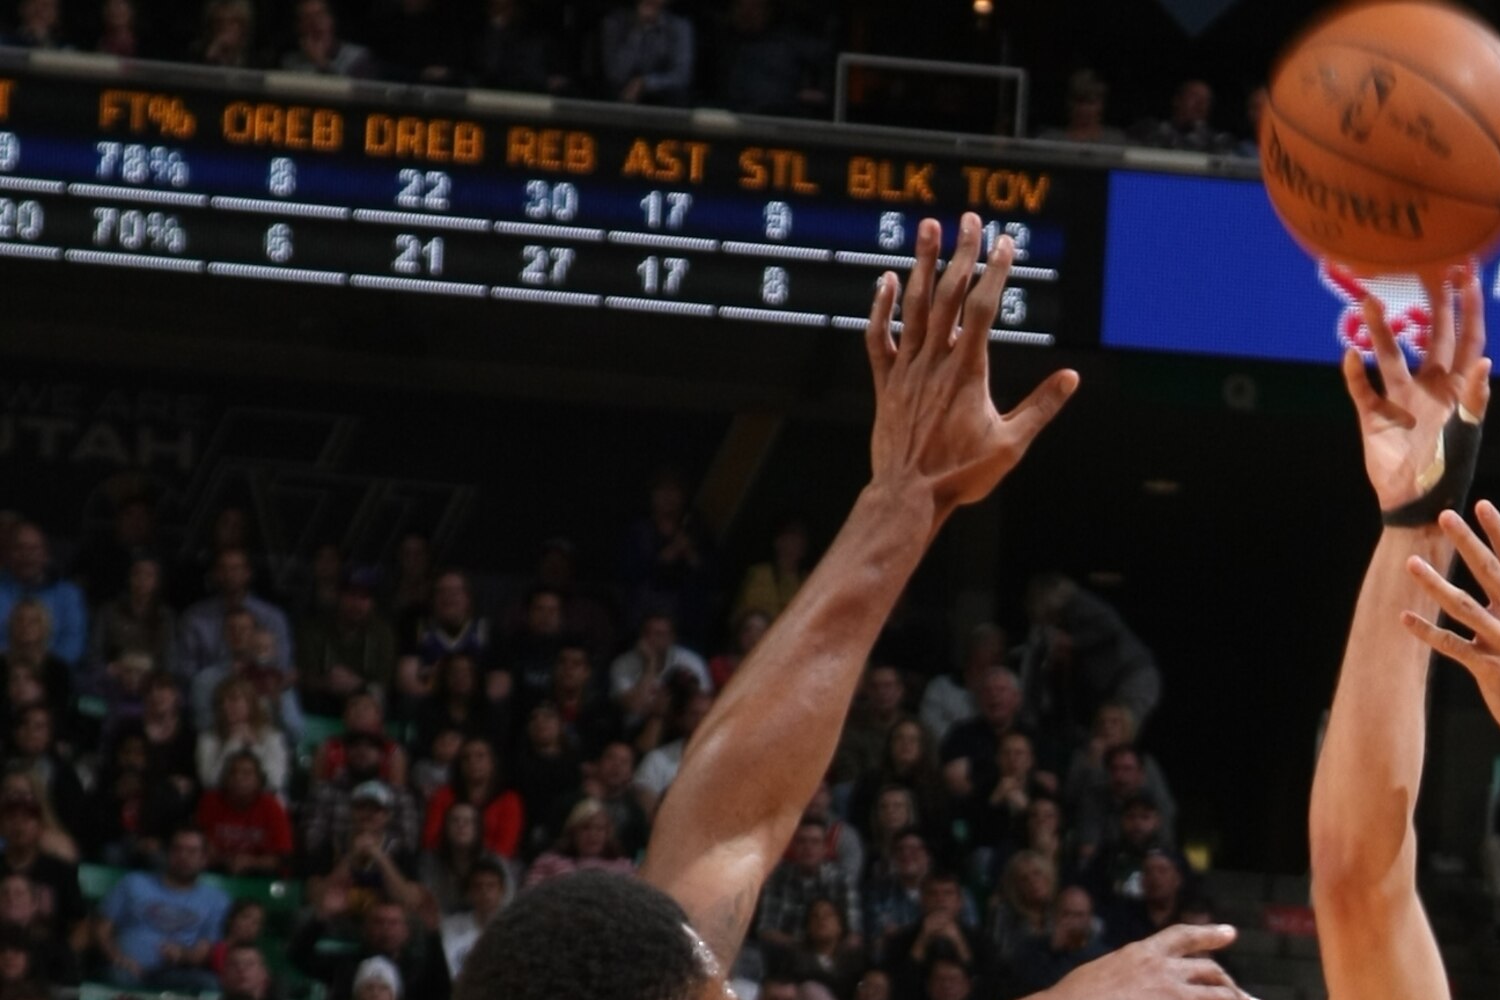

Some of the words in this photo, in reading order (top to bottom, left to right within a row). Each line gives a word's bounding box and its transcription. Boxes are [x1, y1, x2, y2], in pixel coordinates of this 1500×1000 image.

[96, 141, 190, 188] 78%
[269, 157, 297, 197] 8
[397, 168, 452, 211] 22
[525, 180, 579, 222] 30
[640, 190, 693, 231] 17
[763, 201, 793, 240] 9
[878, 211, 905, 249] 5
[98, 89, 197, 139] FT%
[222, 102, 344, 151] OREB
[365, 113, 485, 164] DREB
[507, 126, 596, 174] REB
[622, 137, 711, 182] AST
[739, 147, 819, 193] STL
[848, 157, 936, 203] BLK
[962, 166, 1049, 212] TOV
[92, 206, 187, 253] 70%
[265, 222, 294, 263] 6
[393, 233, 444, 276] 21
[522, 244, 576, 285] 27
[637, 256, 690, 296] 17
[761, 266, 790, 306] 8
